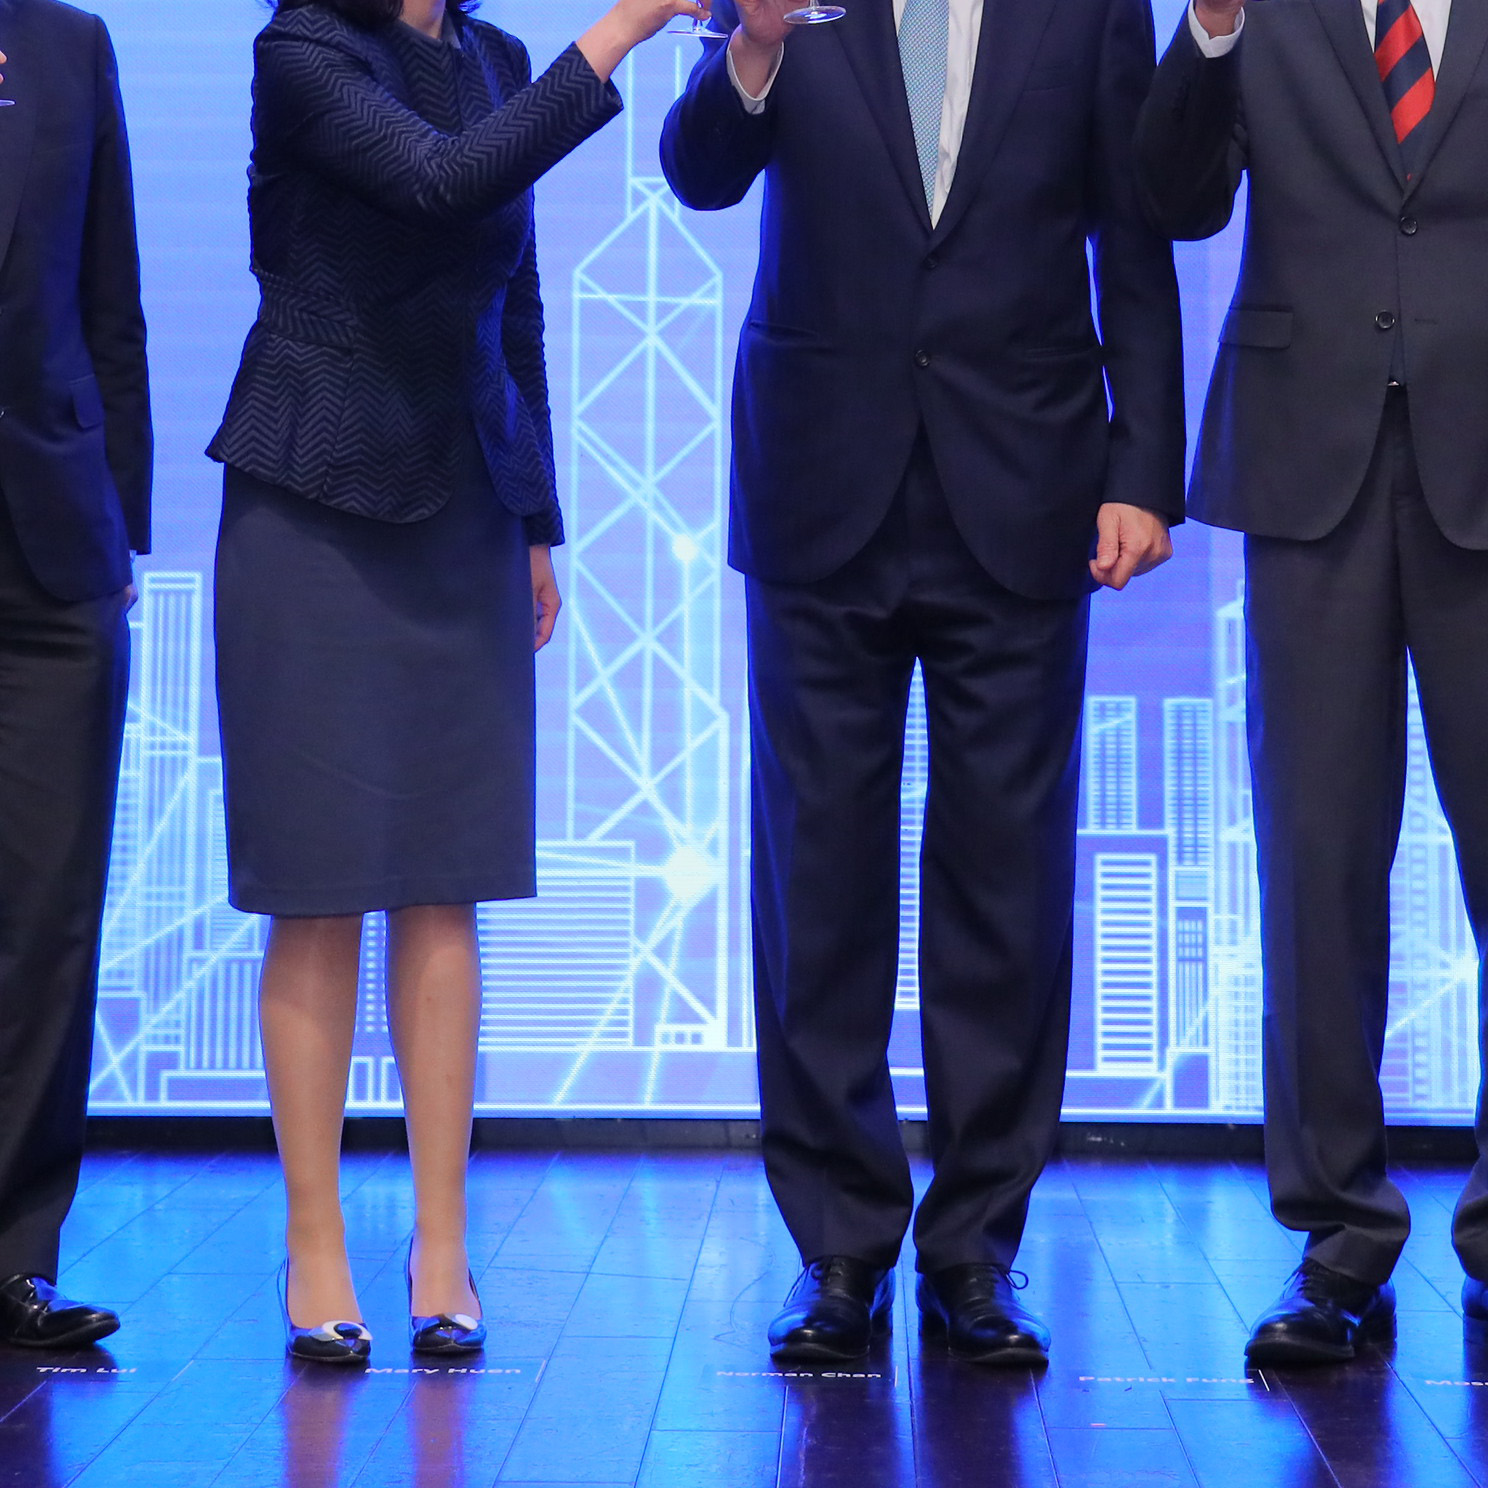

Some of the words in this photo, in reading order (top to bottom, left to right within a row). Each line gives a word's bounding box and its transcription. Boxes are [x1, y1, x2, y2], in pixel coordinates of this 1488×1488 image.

[36, 1366, 88, 1374] Tim
[96, 1366, 139, 1374] Lui
[364, 1367, 440, 1375] Mary
[447, 1367, 522, 1375] Huen
[821, 1371, 882, 1379] Chan
[1078, 1375, 1177, 1384] Patrick
